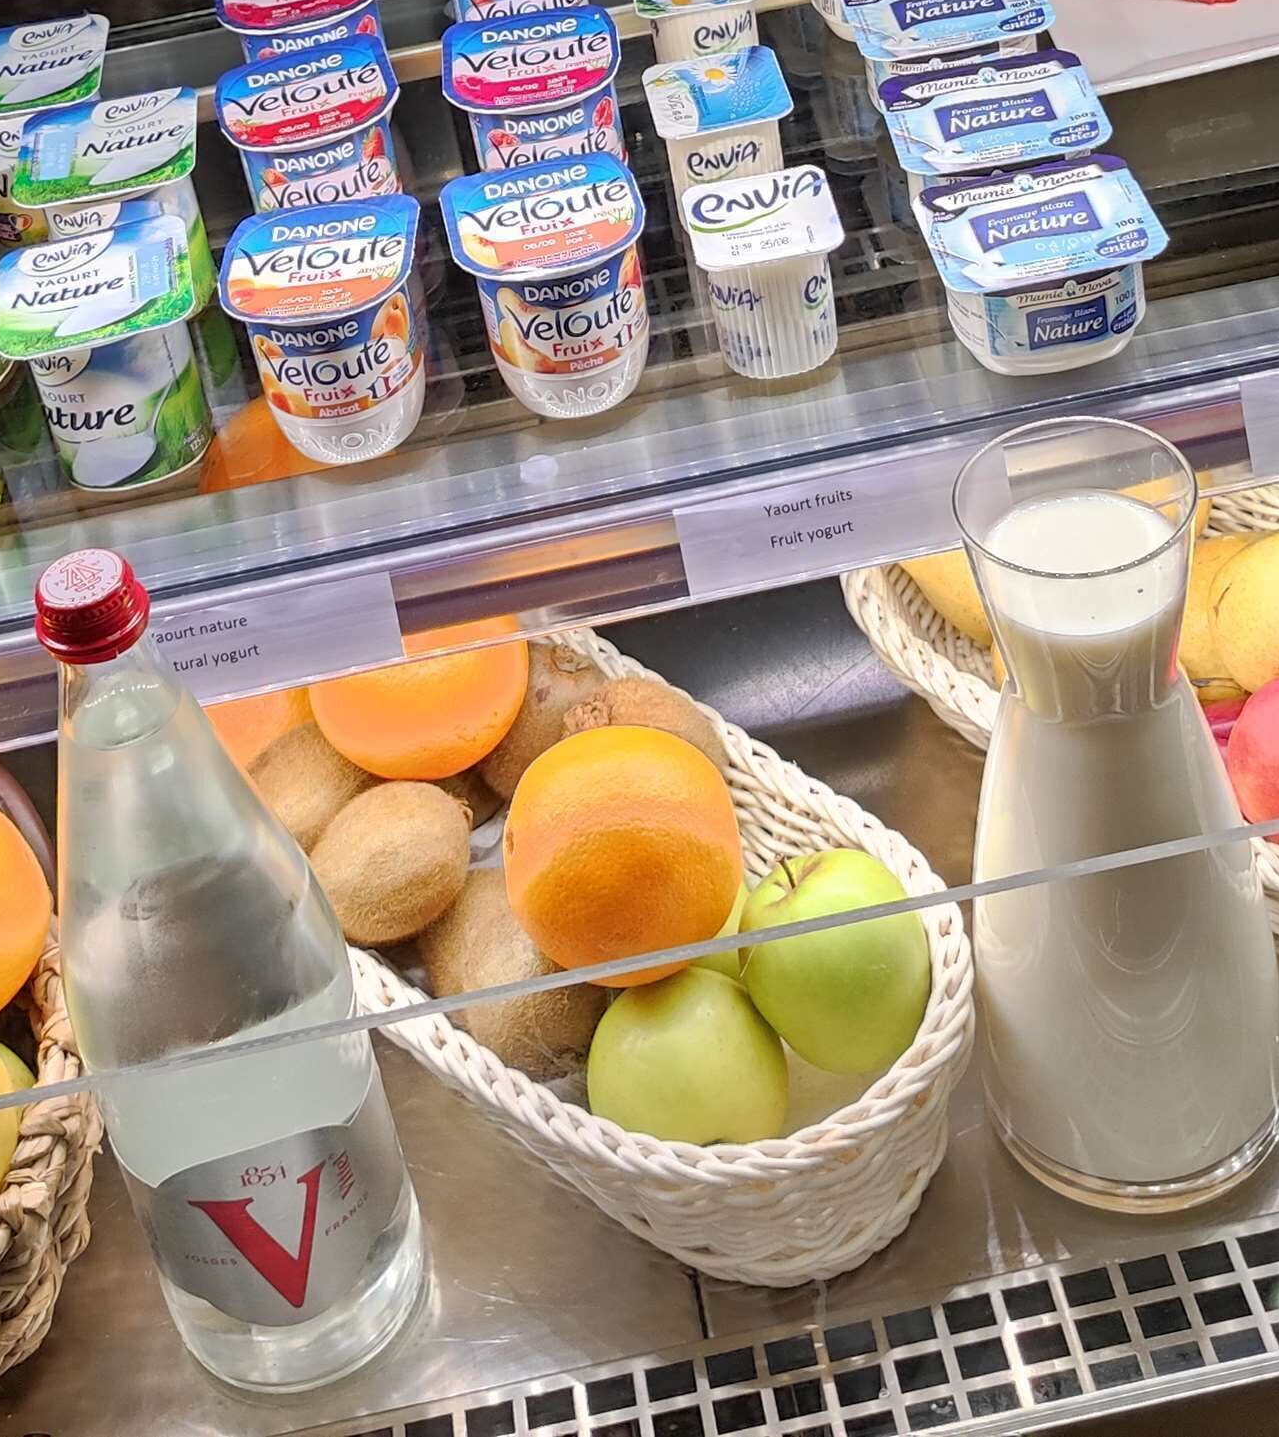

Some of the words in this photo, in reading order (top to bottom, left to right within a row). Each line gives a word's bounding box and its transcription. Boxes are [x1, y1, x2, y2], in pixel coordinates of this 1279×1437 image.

[21, 44, 76, 61] YAOURT
[456, 31, 609, 74] Velouté
[224, 62, 379, 117] Velouté
[915, 77, 979, 94] Mamie
[1000, 66, 1051, 81] Nova
[950, 104, 1046, 133] Nature
[951, 102, 999, 116] Fromage
[1001, 96, 1034, 108] Blanc
[82, 124, 184, 157] Nature
[106, 118, 164, 137] YAOURT
[1052, 128, 1099, 145] entier
[263, 156, 381, 209] Velouté
[948, 186, 1015, 205] Mamie
[1036, 170, 1089, 187] Nova
[458, 177, 629, 233] Velouté
[987, 209, 1039, 227] Fromage
[1041, 199, 1075, 212] Blanc
[520, 217, 575, 236] Fruix
[987, 211, 1089, 244] Nature
[240, 232, 402, 277] Velouté
[1099, 237, 1148, 255] entier
[35, 268, 102, 288] YAOURT
[288, 268, 343, 284] Fruix
[11, 275, 124, 309] Nature
[505, 284, 632, 342] Velouté
[1033, 315, 1104, 342] Nature
[260, 332, 391, 386] Velouté
[552, 337, 604, 358] Fruix
[569, 356, 604, 371] Pêche
[303, 385, 356, 402] Fruix
[319, 402, 360, 418] Abricot
[763, 498, 812, 517] Yaourt
[814, 489, 853, 507] fruits
[770, 530, 804, 549] Fruit
[807, 520, 854, 543] yogurt
[199, 615, 248, 634] nature
[173, 654, 209, 673] tural
[212, 644, 260, 667] yogurt
[240, 1160, 287, 1188] 1854
[187, 1159, 326, 1308] V
